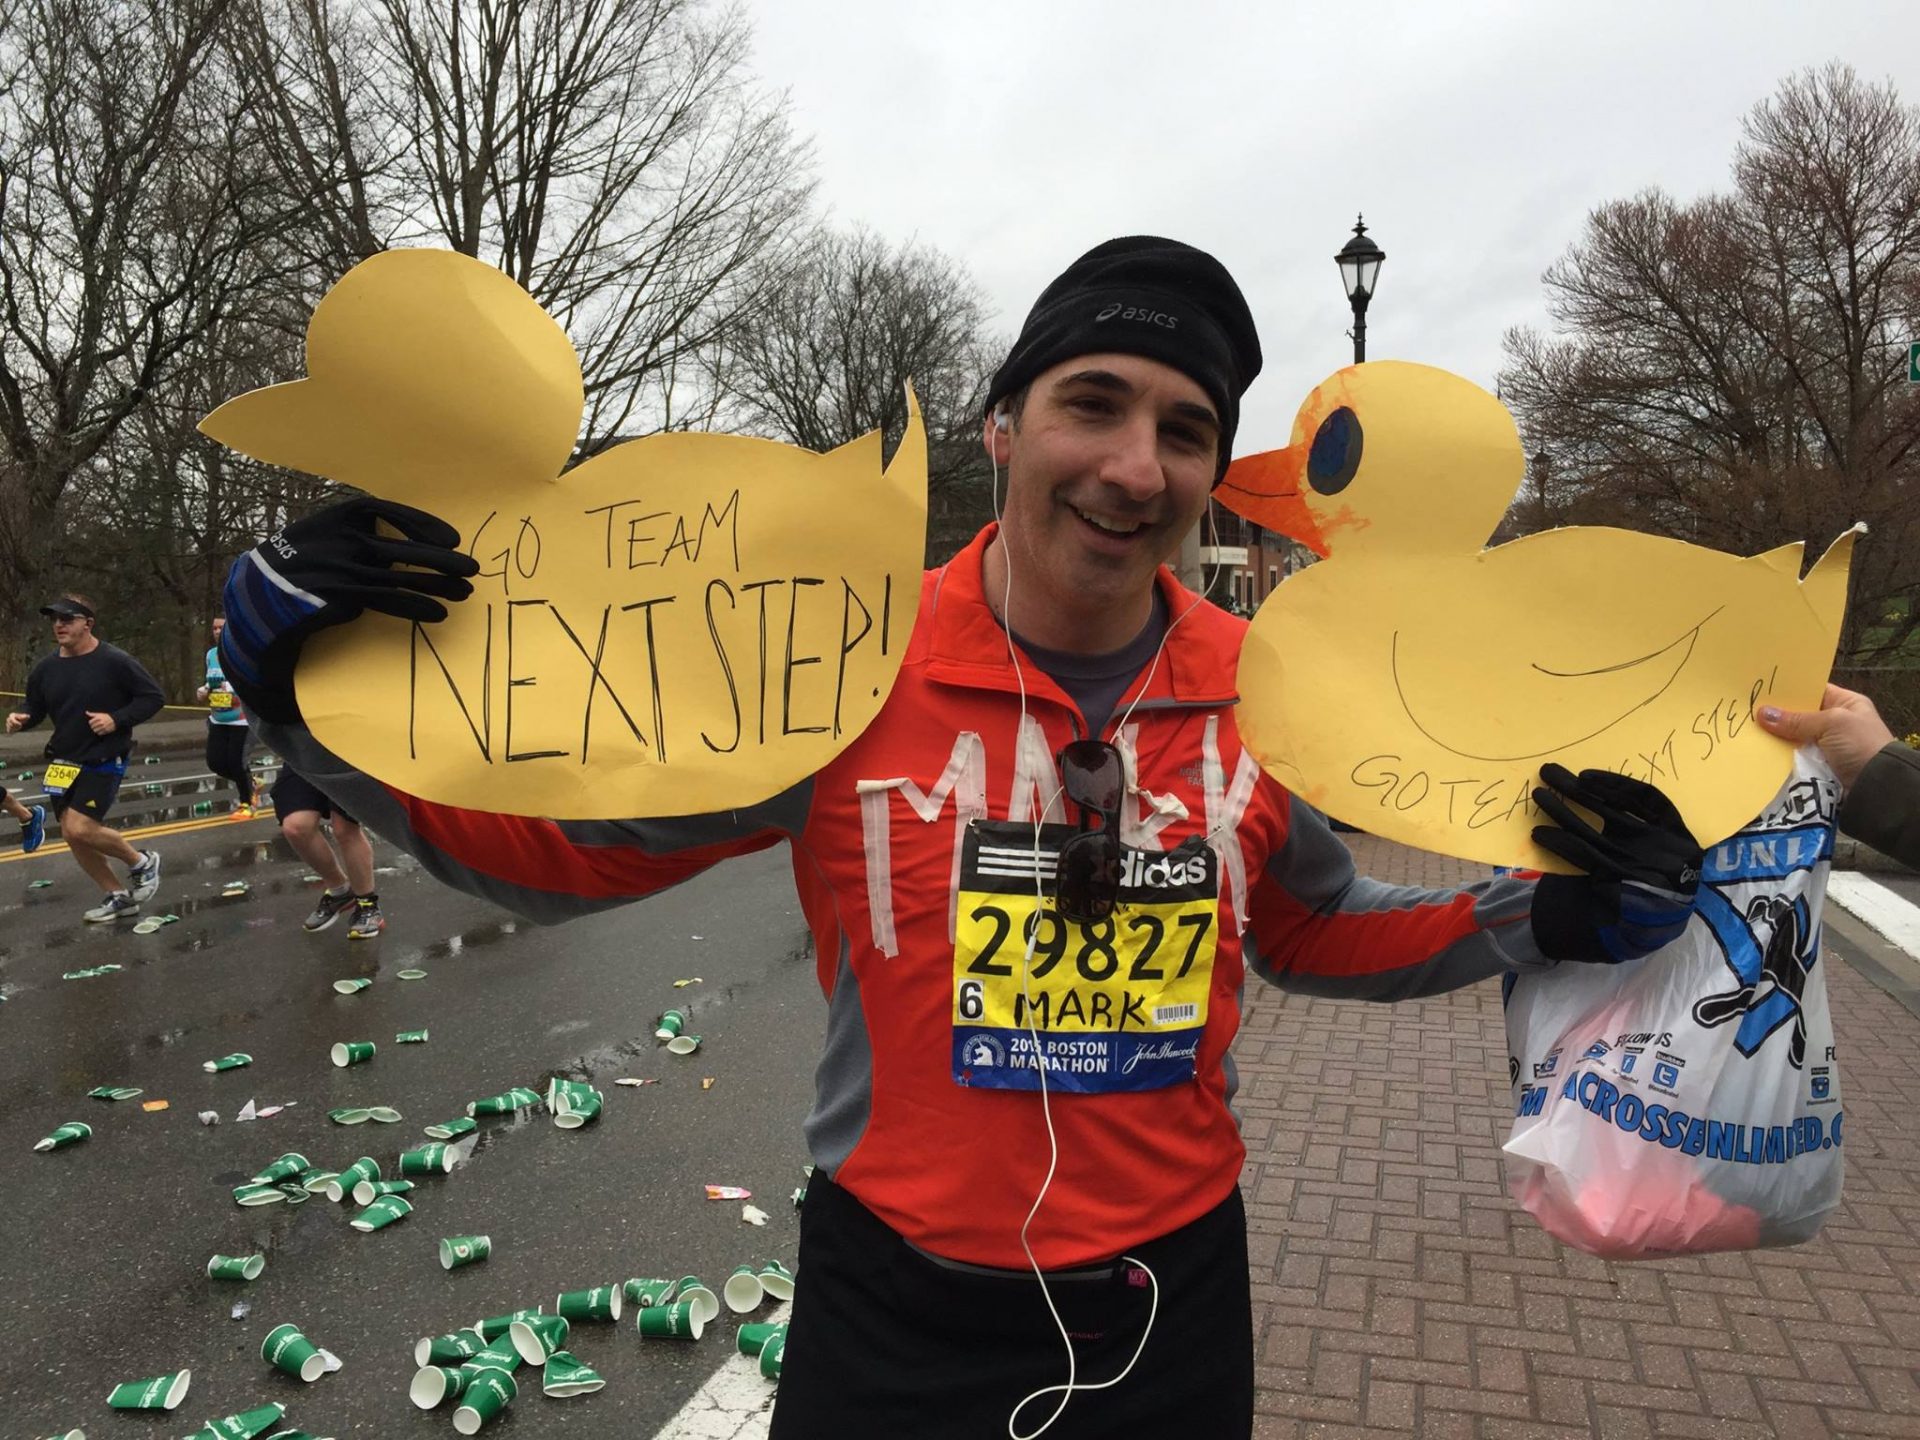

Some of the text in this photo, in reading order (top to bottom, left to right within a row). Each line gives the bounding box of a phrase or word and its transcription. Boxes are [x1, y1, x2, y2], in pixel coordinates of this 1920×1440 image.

[1121, 306, 1179, 329] asics
[269, 532, 298, 559] asics
[469, 488, 740, 595] GO TEAM
[409, 574, 891, 765] NEXT STEP!
[1351, 755, 1429, 811] GO
[1439, 778, 1544, 829] TEA
[1119, 850, 1208, 889] didas
[966, 904, 1214, 982] 29827
[958, 981, 984, 1020] 6
[1013, 987, 1147, 1032] MARK
[1010, 1055, 1108, 1073] MARATHON
[1047, 1041, 1108, 1056] BOSTON
